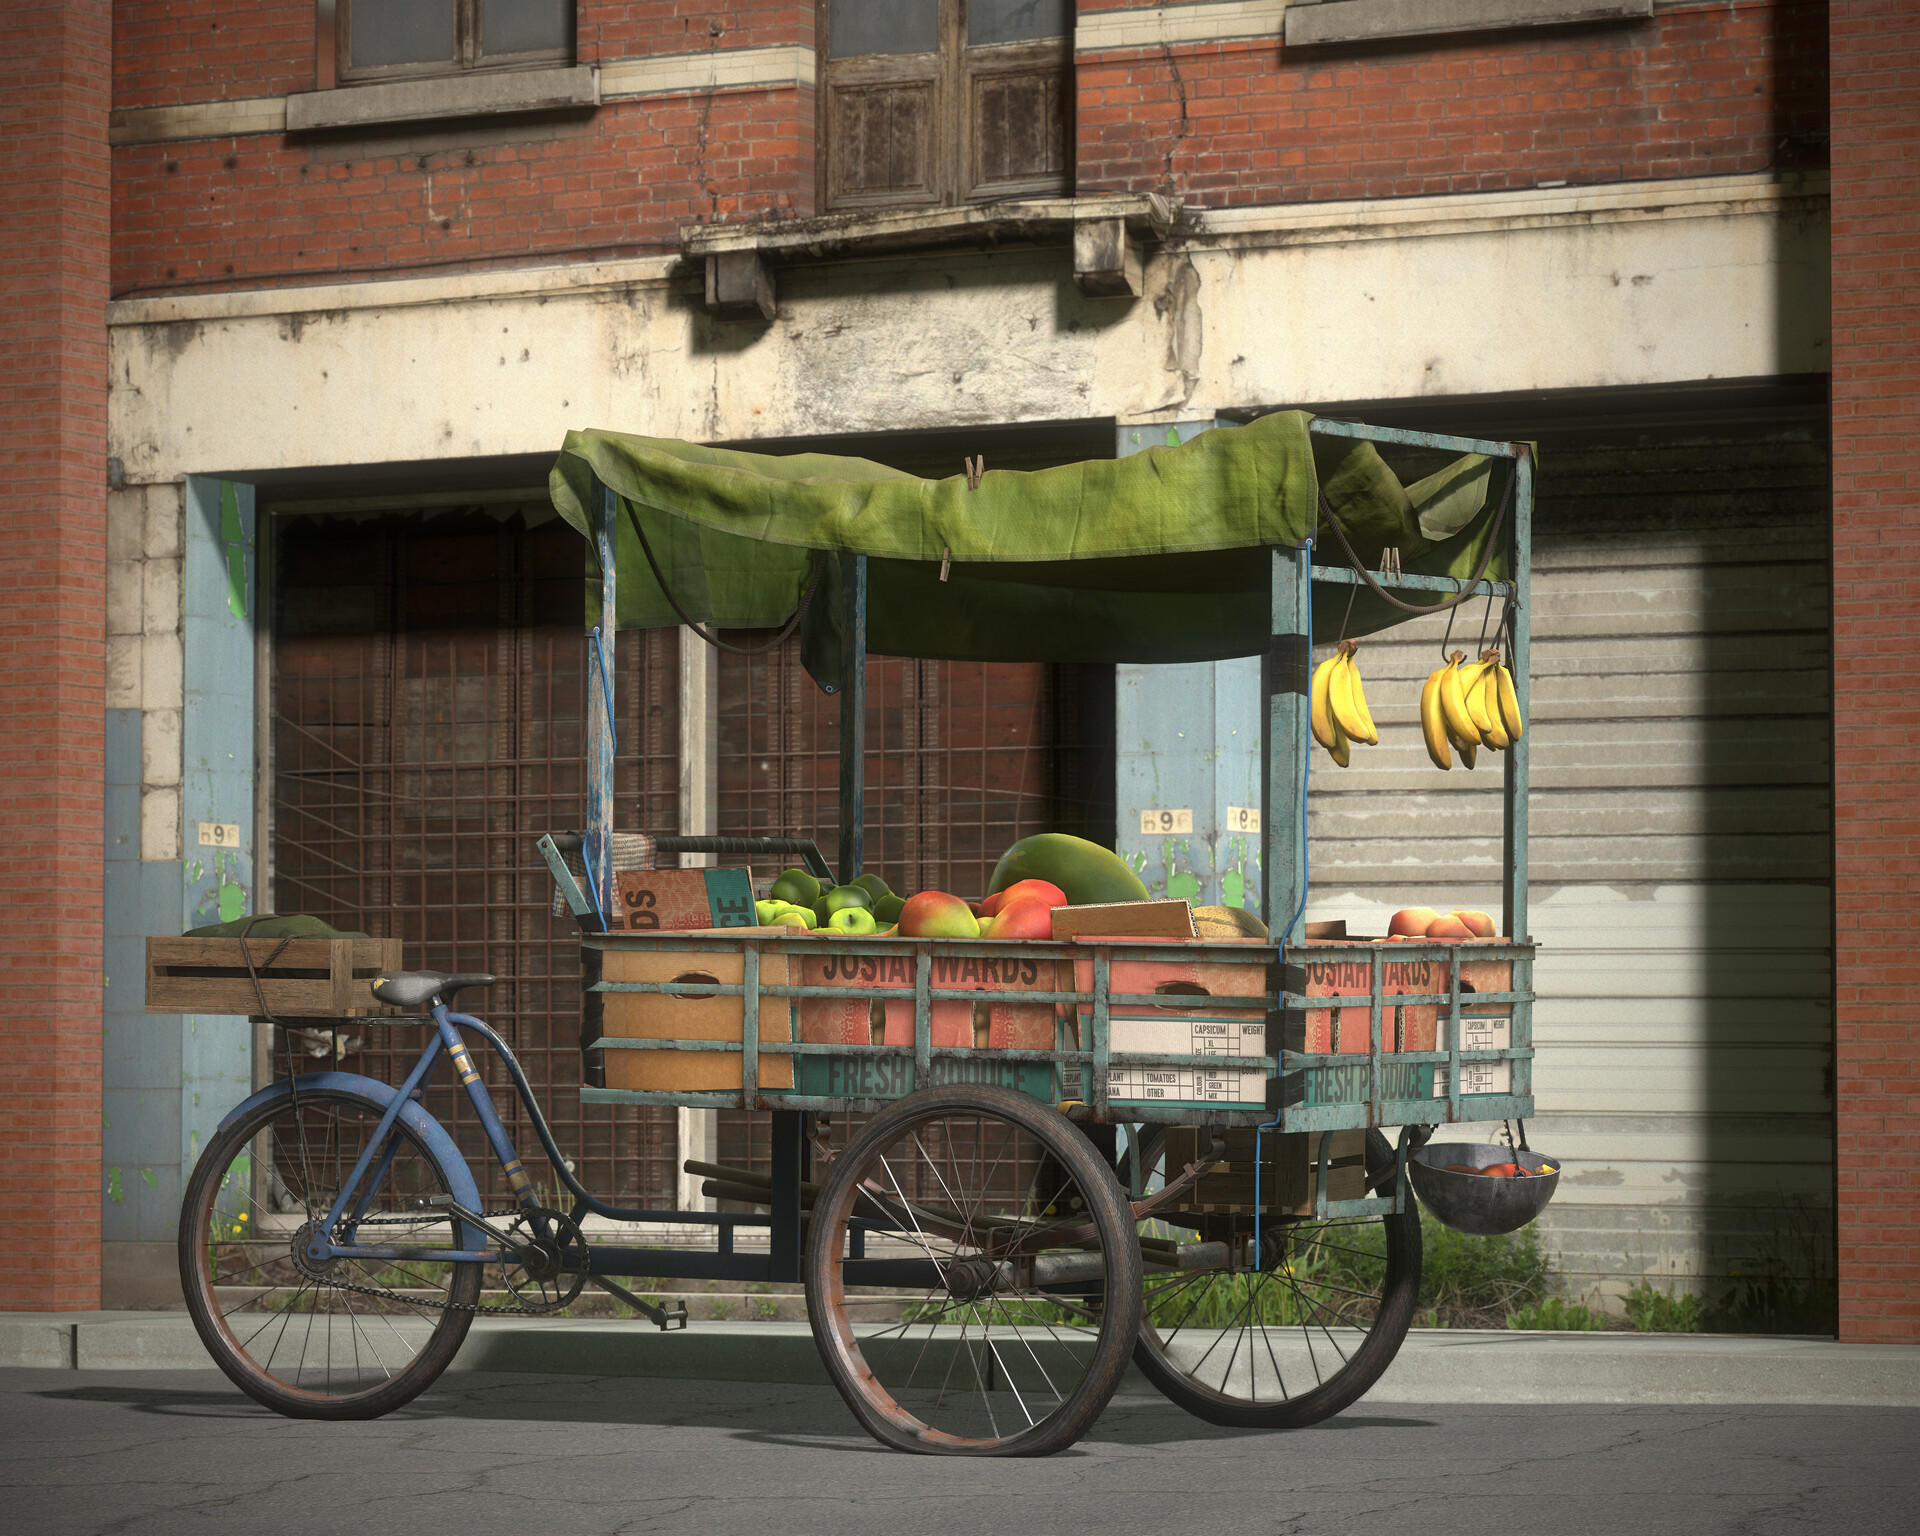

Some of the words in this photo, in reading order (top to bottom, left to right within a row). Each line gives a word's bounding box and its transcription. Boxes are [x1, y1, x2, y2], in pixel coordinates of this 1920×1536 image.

[936, 957, 1038, 985] WARDS
[1194, 1024, 1226, 1035] CAPSICUM
[1242, 1025, 1264, 1035] WEIGHT
[828, 1054, 906, 1094] FRESH
[930, 1057, 1027, 1092] RODUCE
[1146, 1073, 1176, 1083] TOMATOES
[1208, 1071, 1217, 1079] RED
[1208, 1082, 1223, 1090] GREEN
[1305, 1065, 1354, 1104] FRESH
[1359, 1062, 1422, 1102] PODUCE
[1146, 1088, 1165, 1098] OTHER
[1208, 1092, 1218, 1100] MIX
